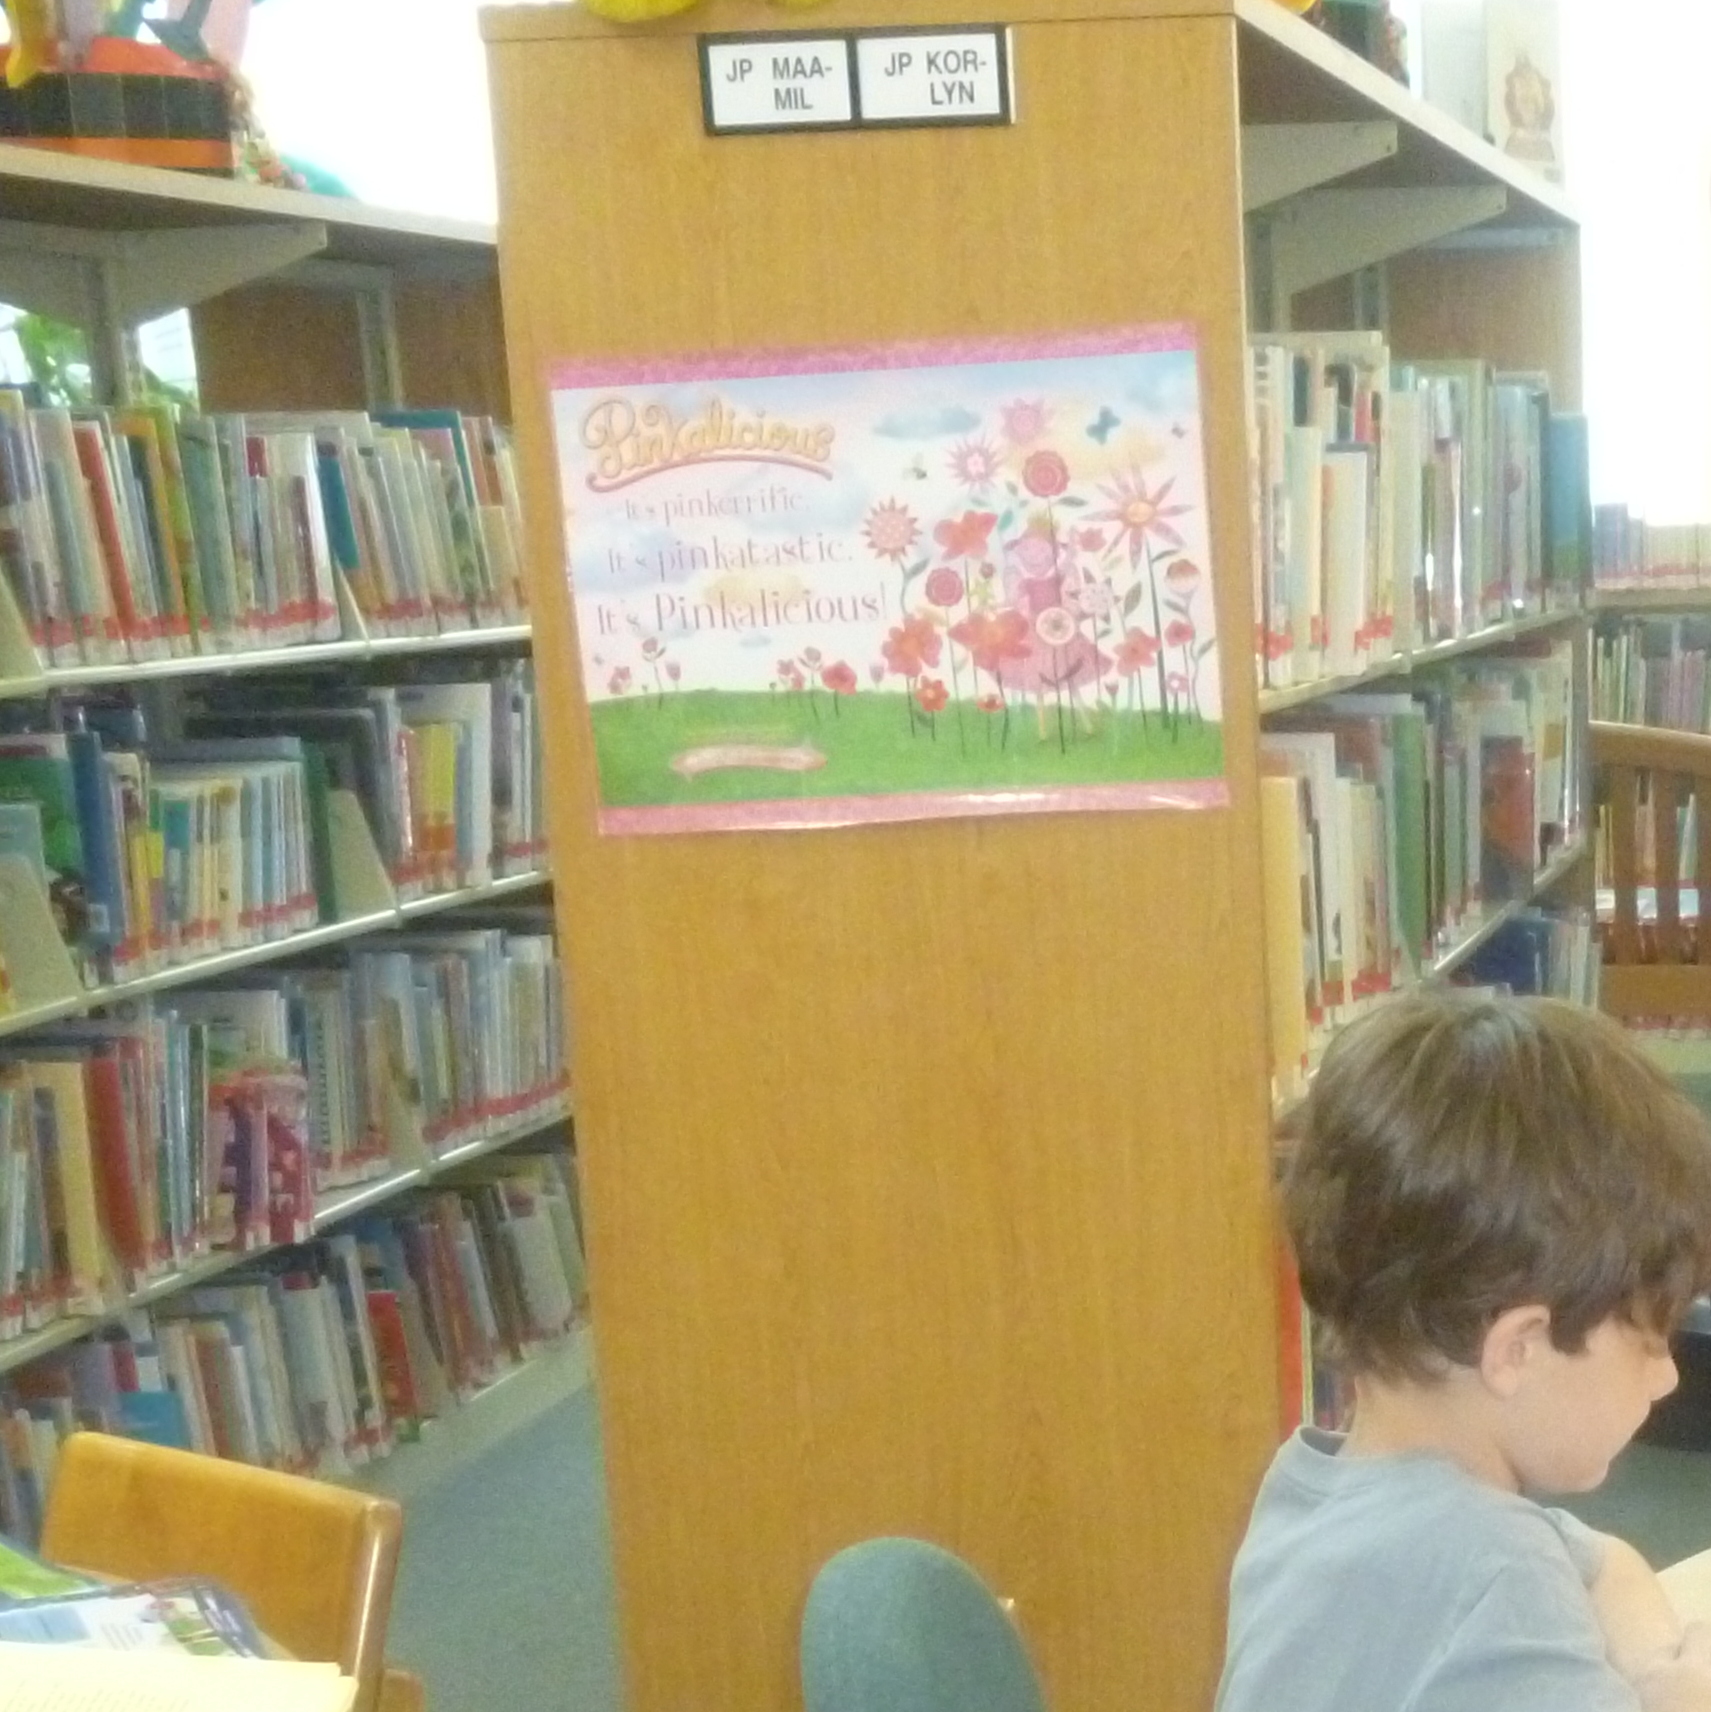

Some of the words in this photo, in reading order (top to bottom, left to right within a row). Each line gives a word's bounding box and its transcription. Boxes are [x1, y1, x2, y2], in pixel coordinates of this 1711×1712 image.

[726, 58, 753, 83] JP
[772, 55, 833, 80] MAA-
[884, 51, 912, 76] JP
[926, 49, 987, 75] KOR-
[773, 86, 814, 111] MIL
[929, 80, 975, 106] LYN
[581, 396, 836, 479] Pinkalicious
[657, 532, 853, 584] pinkatastic.
[655, 581, 888, 633] Pinkalicious!
